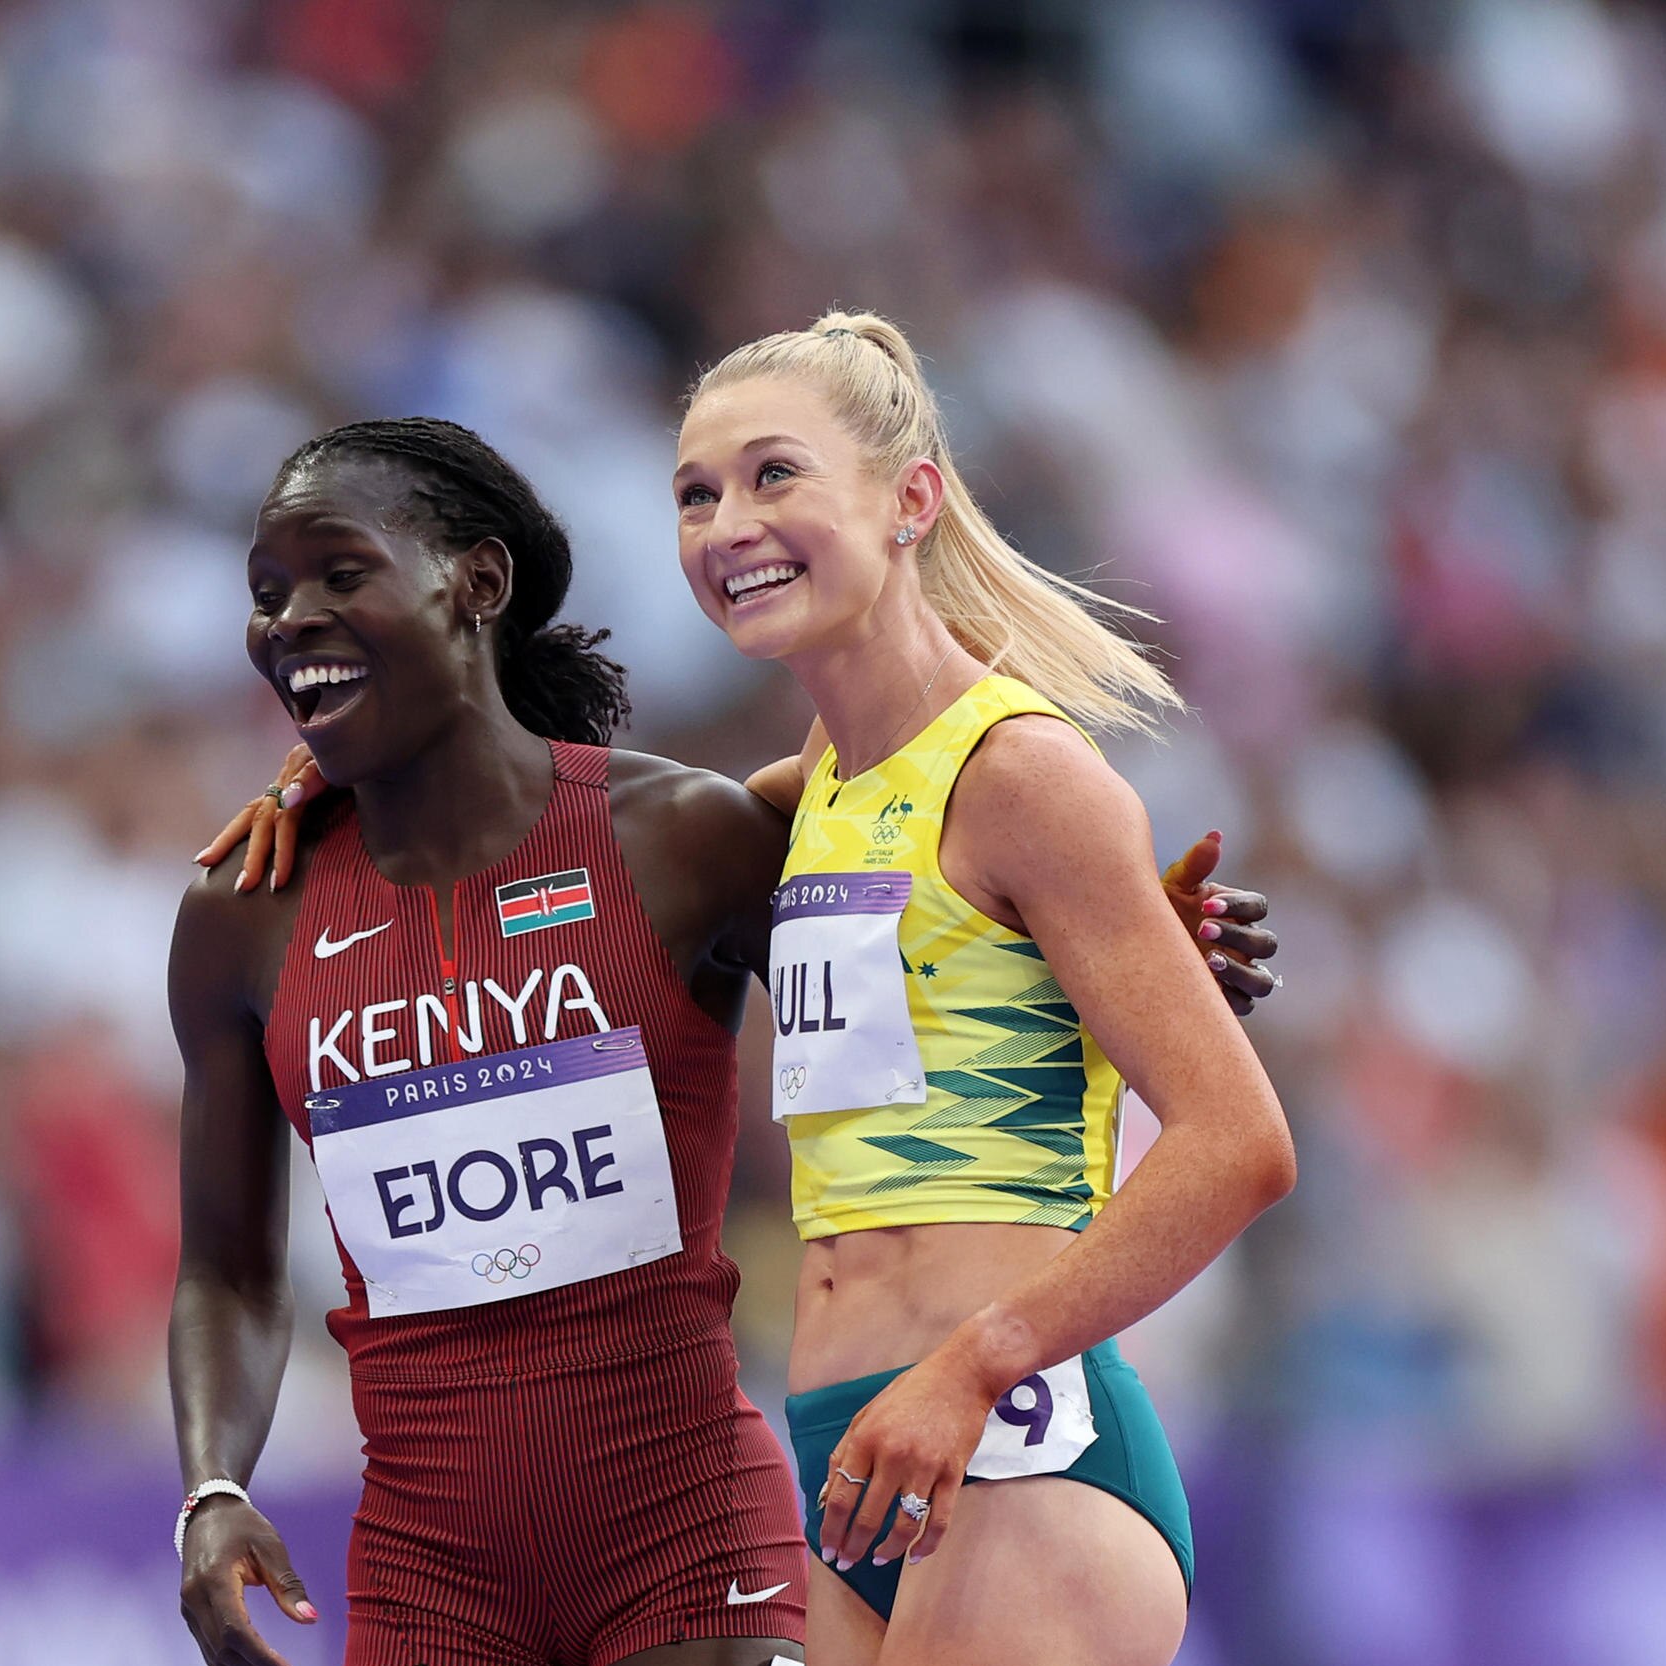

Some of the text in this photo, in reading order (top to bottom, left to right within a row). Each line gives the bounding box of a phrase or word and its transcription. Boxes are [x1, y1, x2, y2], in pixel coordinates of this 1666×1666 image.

[801, 885, 848, 904] 2024
[309, 964, 611, 1092] KENYA
[385, 1056, 553, 1107] PARIS 2024
[373, 1124, 624, 1240] EJORE
[994, 1373, 1053, 1447] 9
